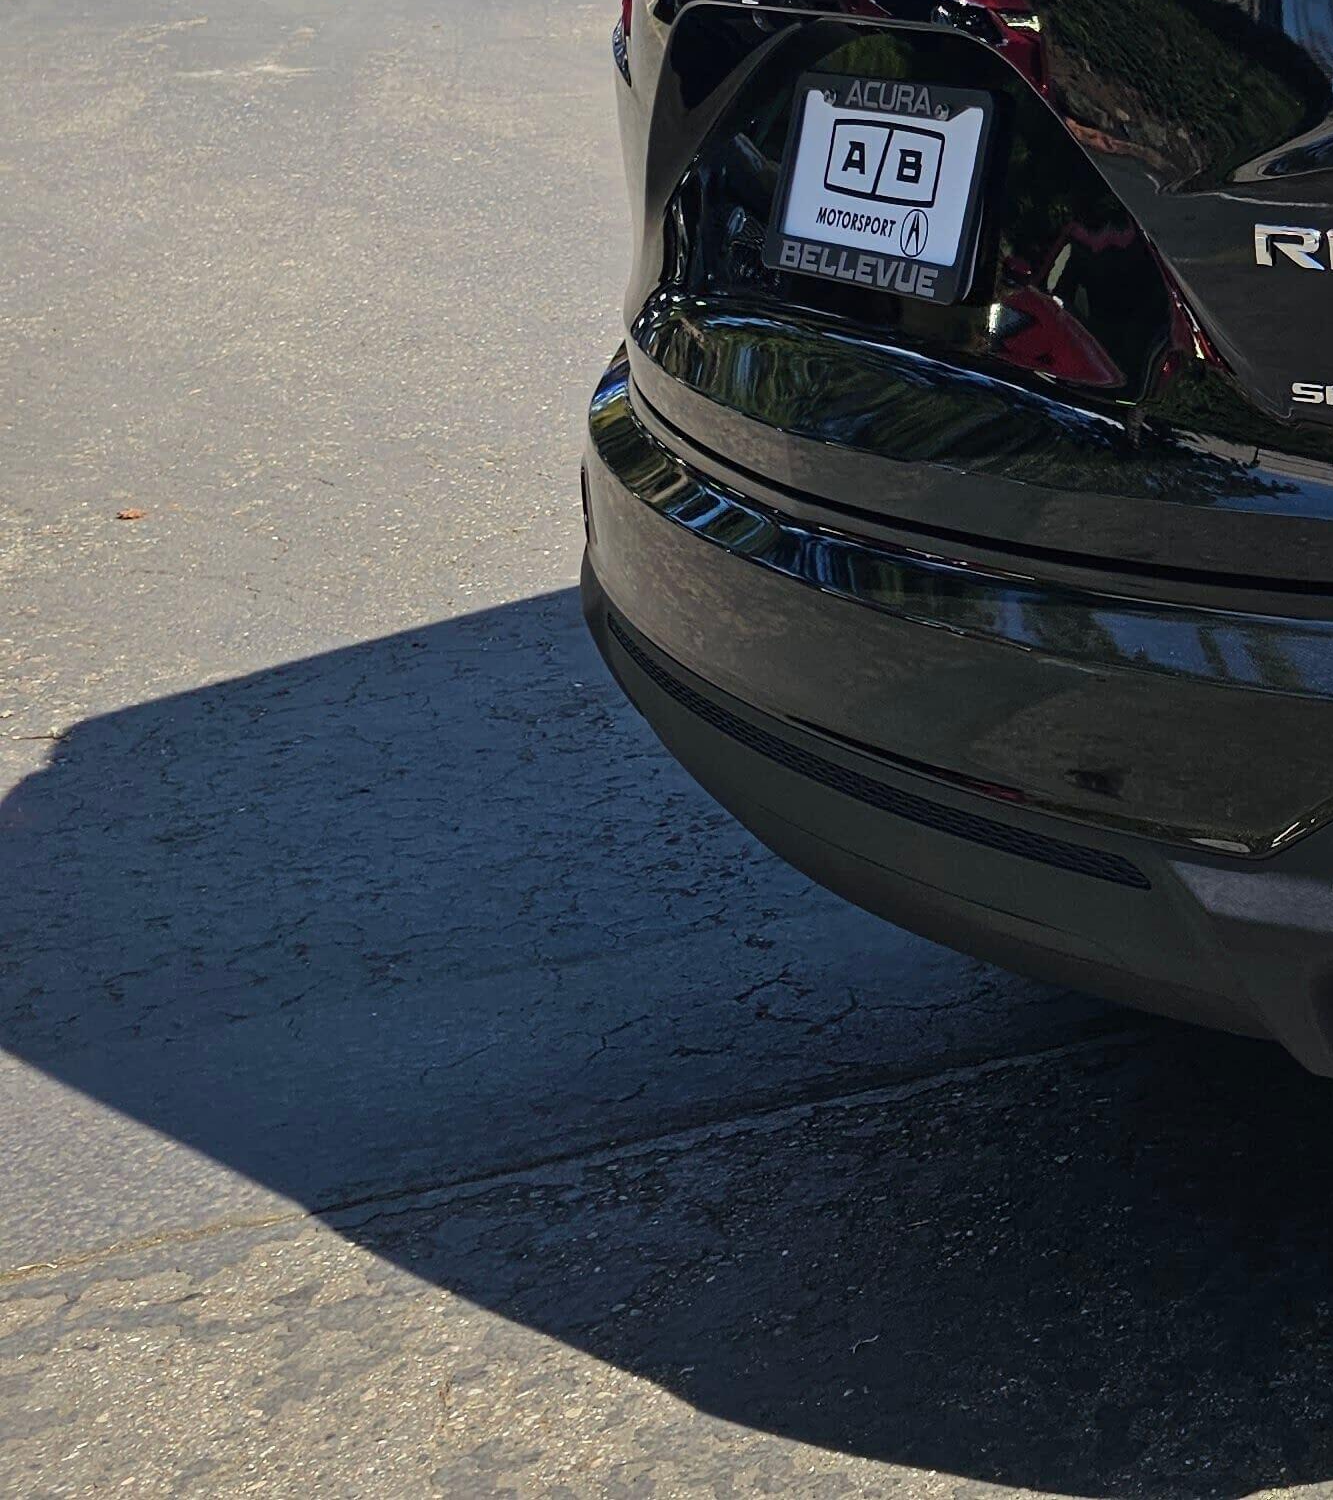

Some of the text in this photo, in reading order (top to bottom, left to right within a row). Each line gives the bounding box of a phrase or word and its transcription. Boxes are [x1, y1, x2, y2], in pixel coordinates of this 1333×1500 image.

[845, 80, 931, 116] ACURA
[842, 141, 922, 184] A B
[815, 207, 897, 238] MOTORSPORT
[779, 240, 939, 298] BELLEVUE
